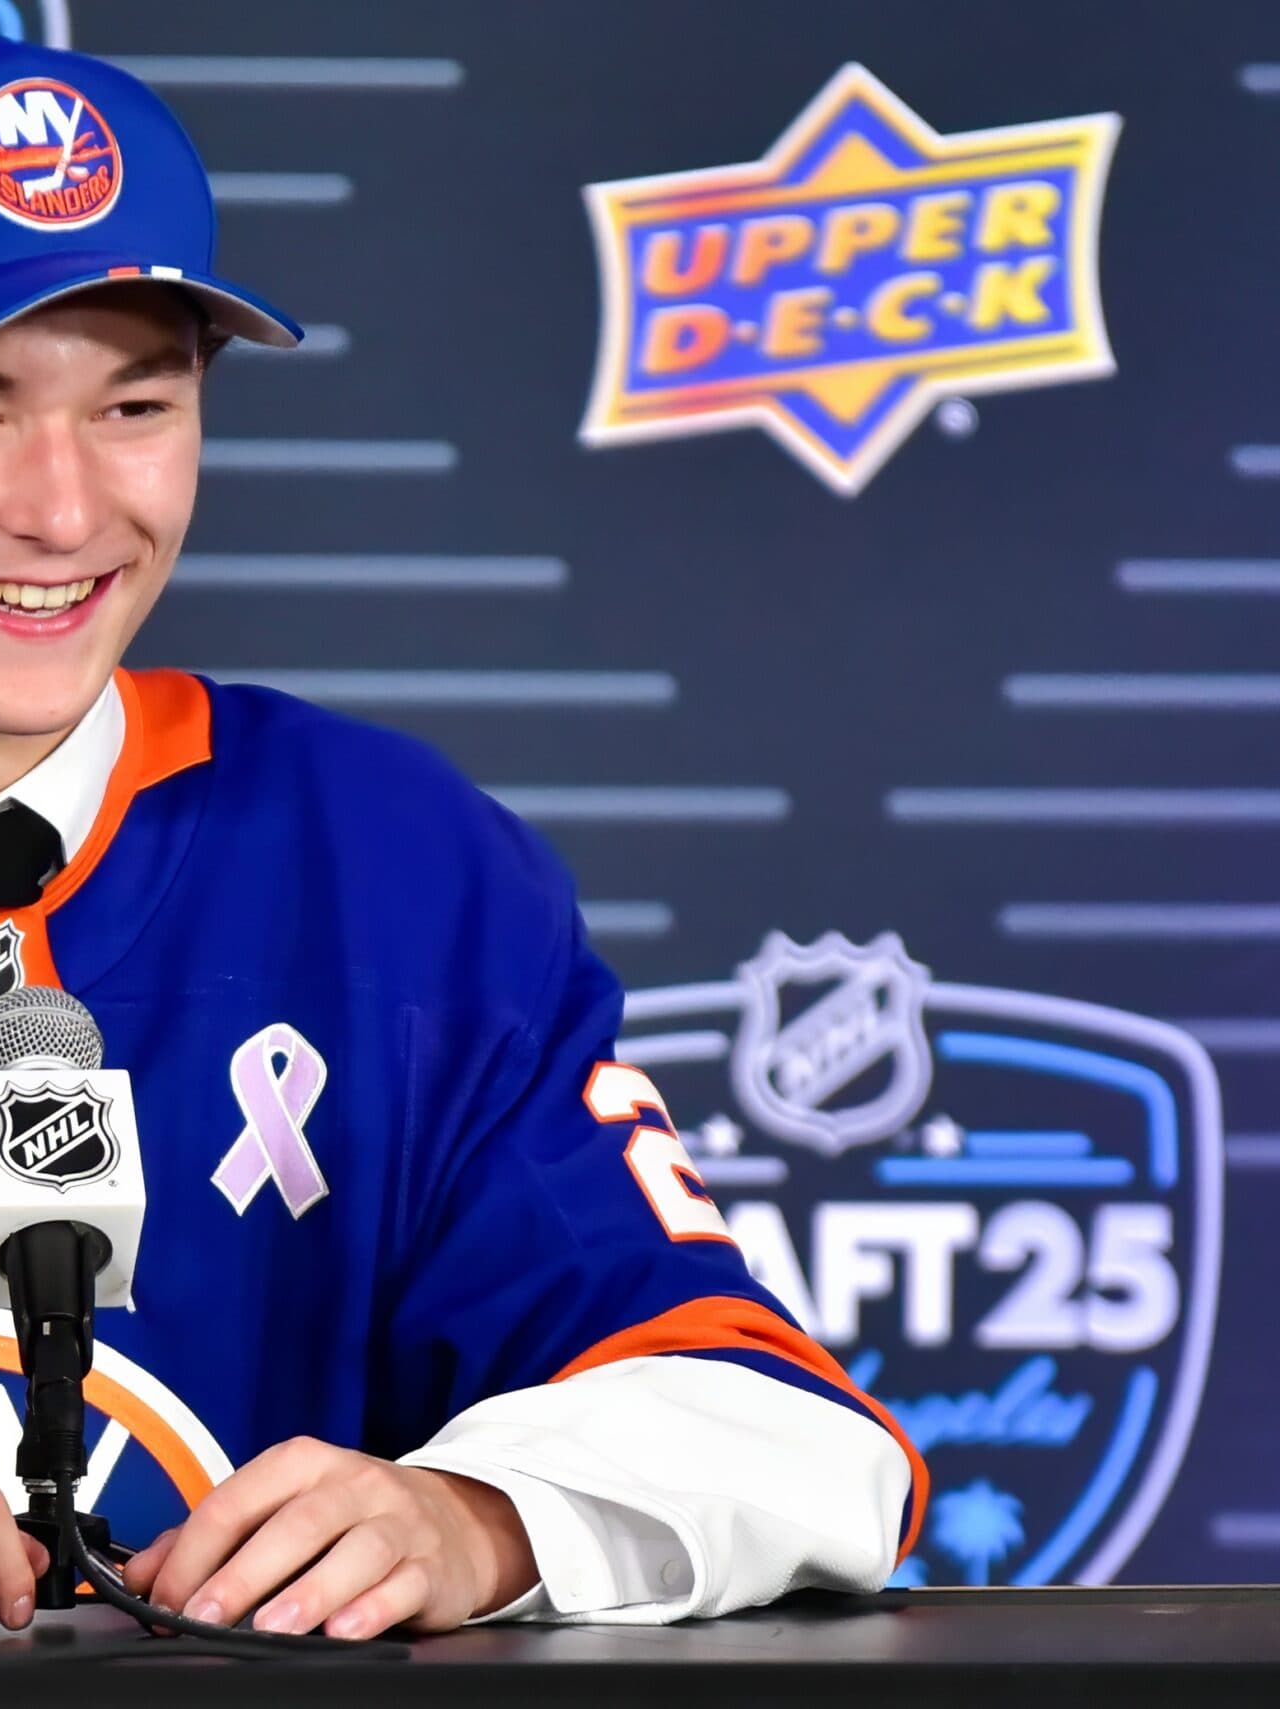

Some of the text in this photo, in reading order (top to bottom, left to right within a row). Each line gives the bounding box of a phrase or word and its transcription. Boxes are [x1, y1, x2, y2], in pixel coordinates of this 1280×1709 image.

[641, 180, 1062, 296] UPPER
[22, 1109, 91, 1170] NHL
[720, 1200, 1180, 1352] AFT25
